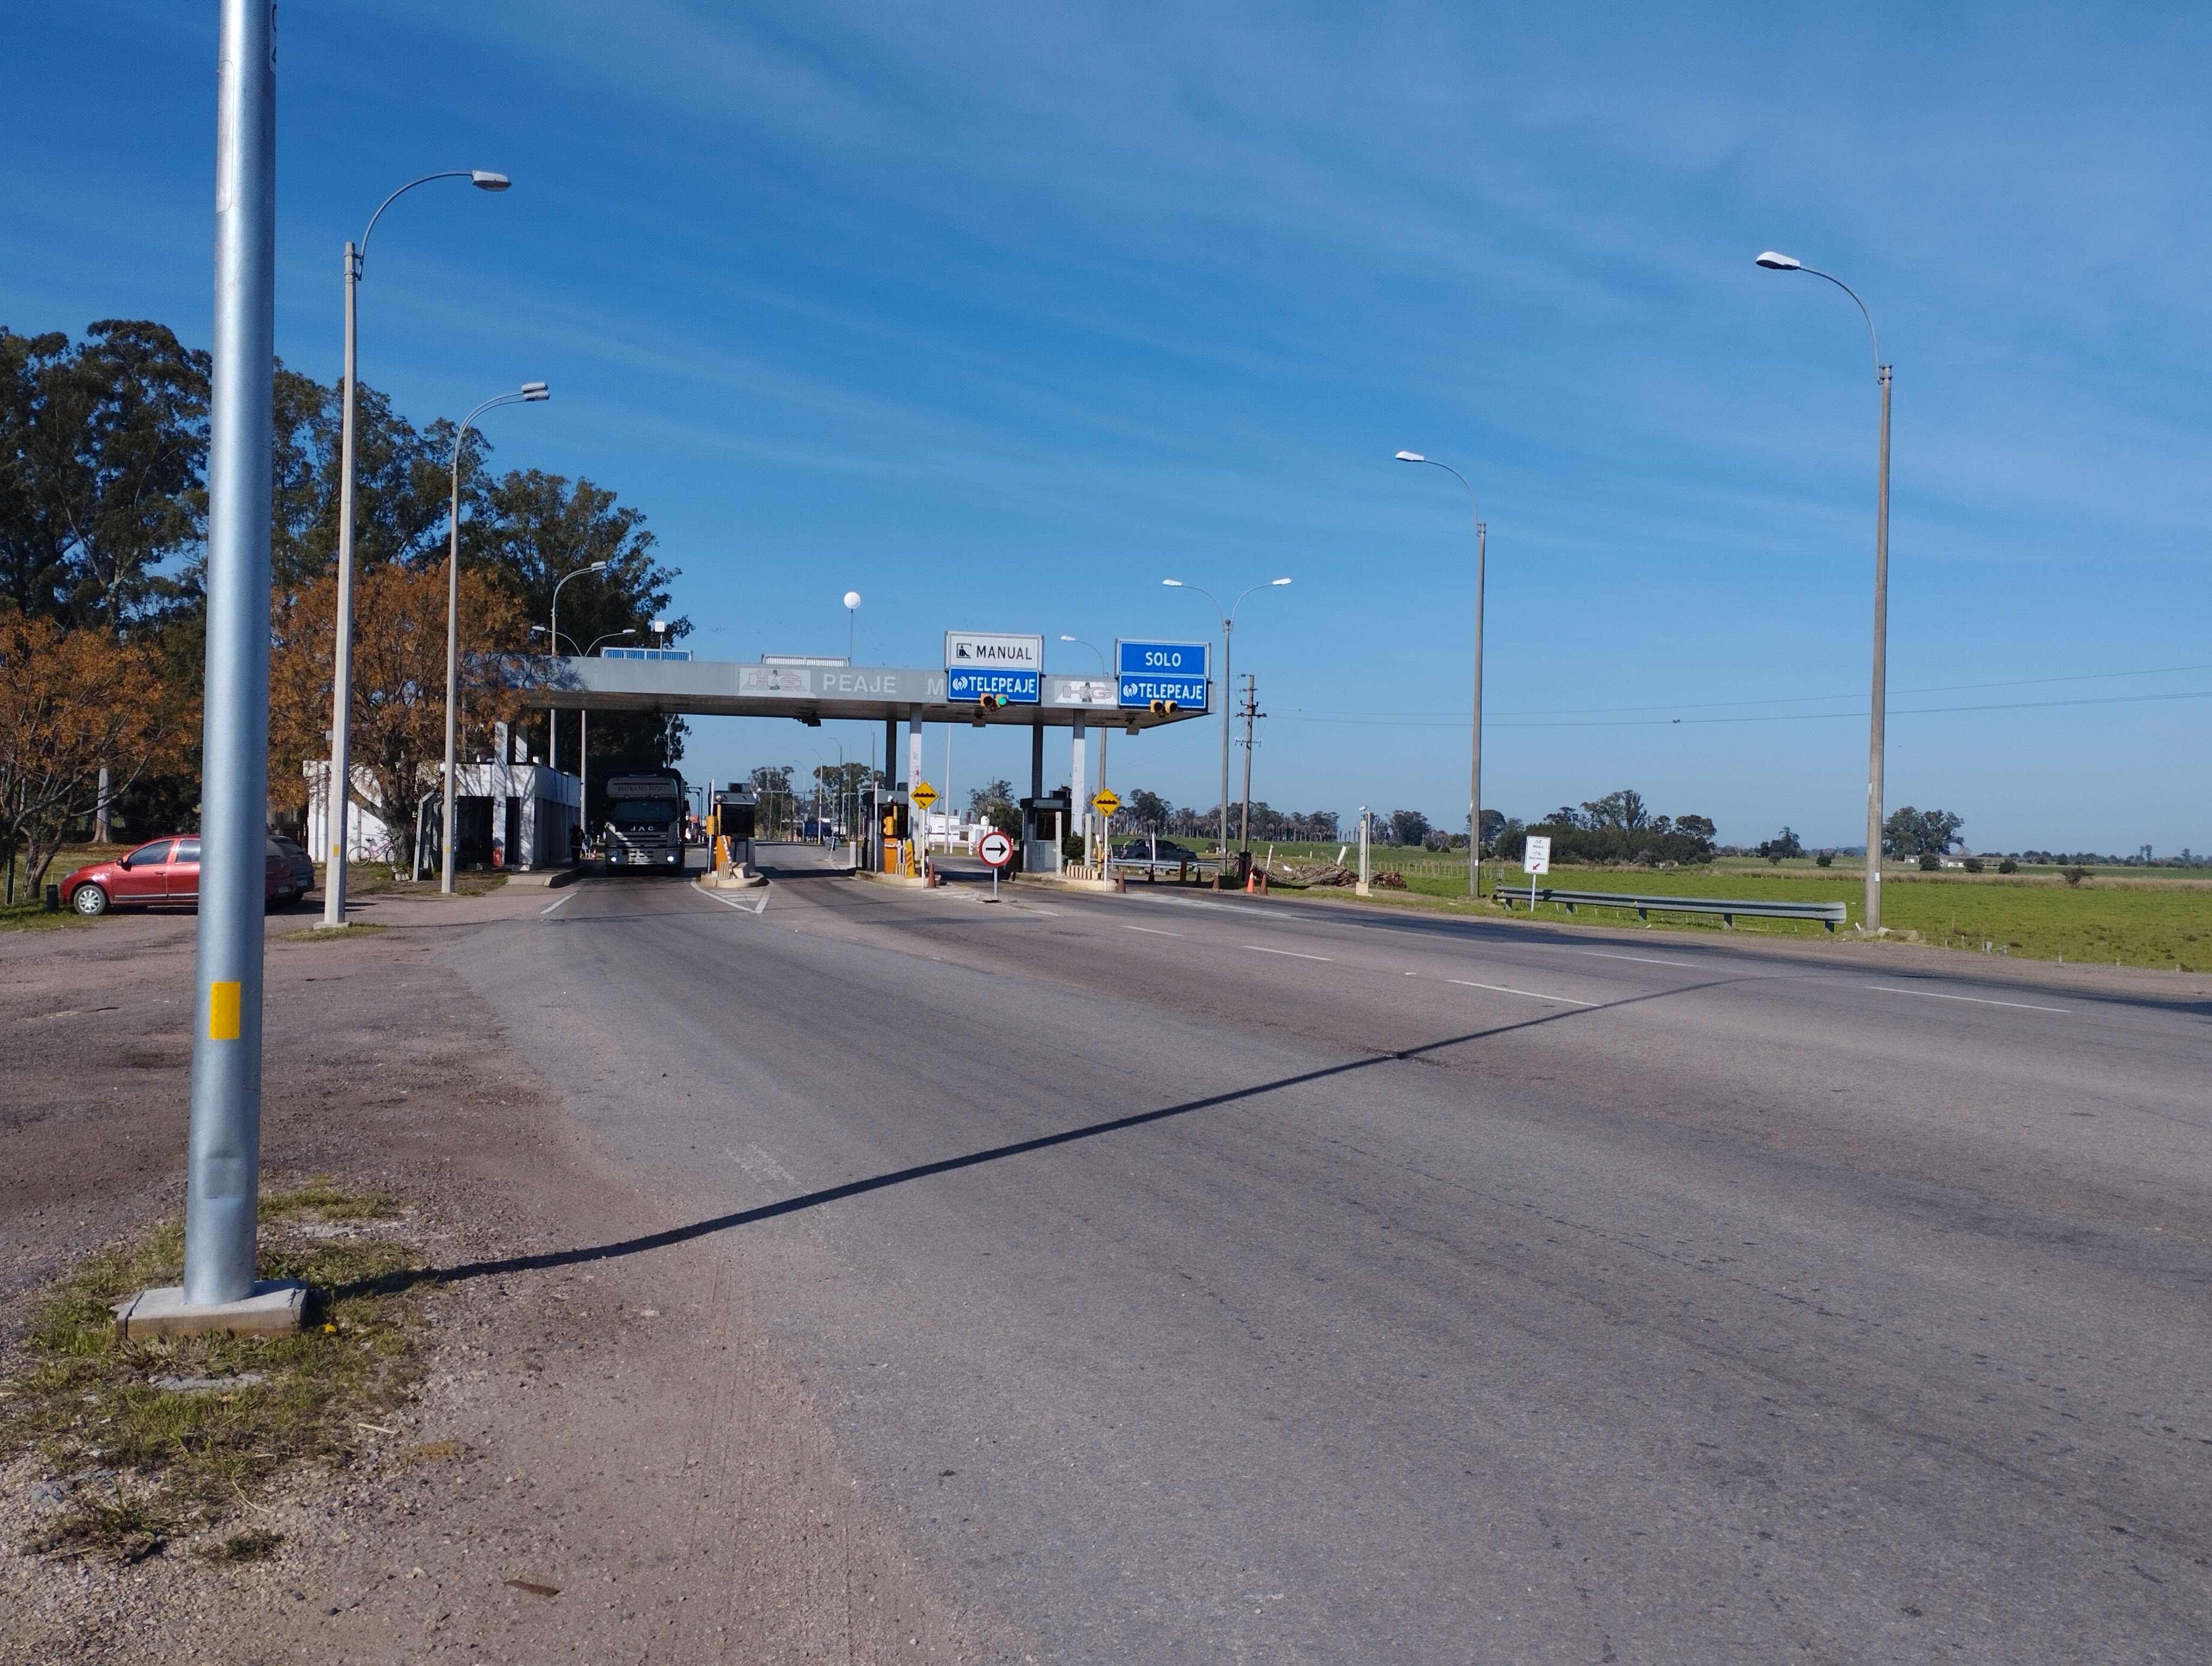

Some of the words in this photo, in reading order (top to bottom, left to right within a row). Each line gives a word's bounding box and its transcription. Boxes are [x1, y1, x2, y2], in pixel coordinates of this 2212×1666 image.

[976, 645, 1032, 660] MANUAL
[1145, 652, 1181, 667] SOLO
[823, 674, 897, 694] PEAJE
[969, 676, 1036, 693] TELEPEAJE
[1139, 683, 1203, 700] TELEPEAJE
